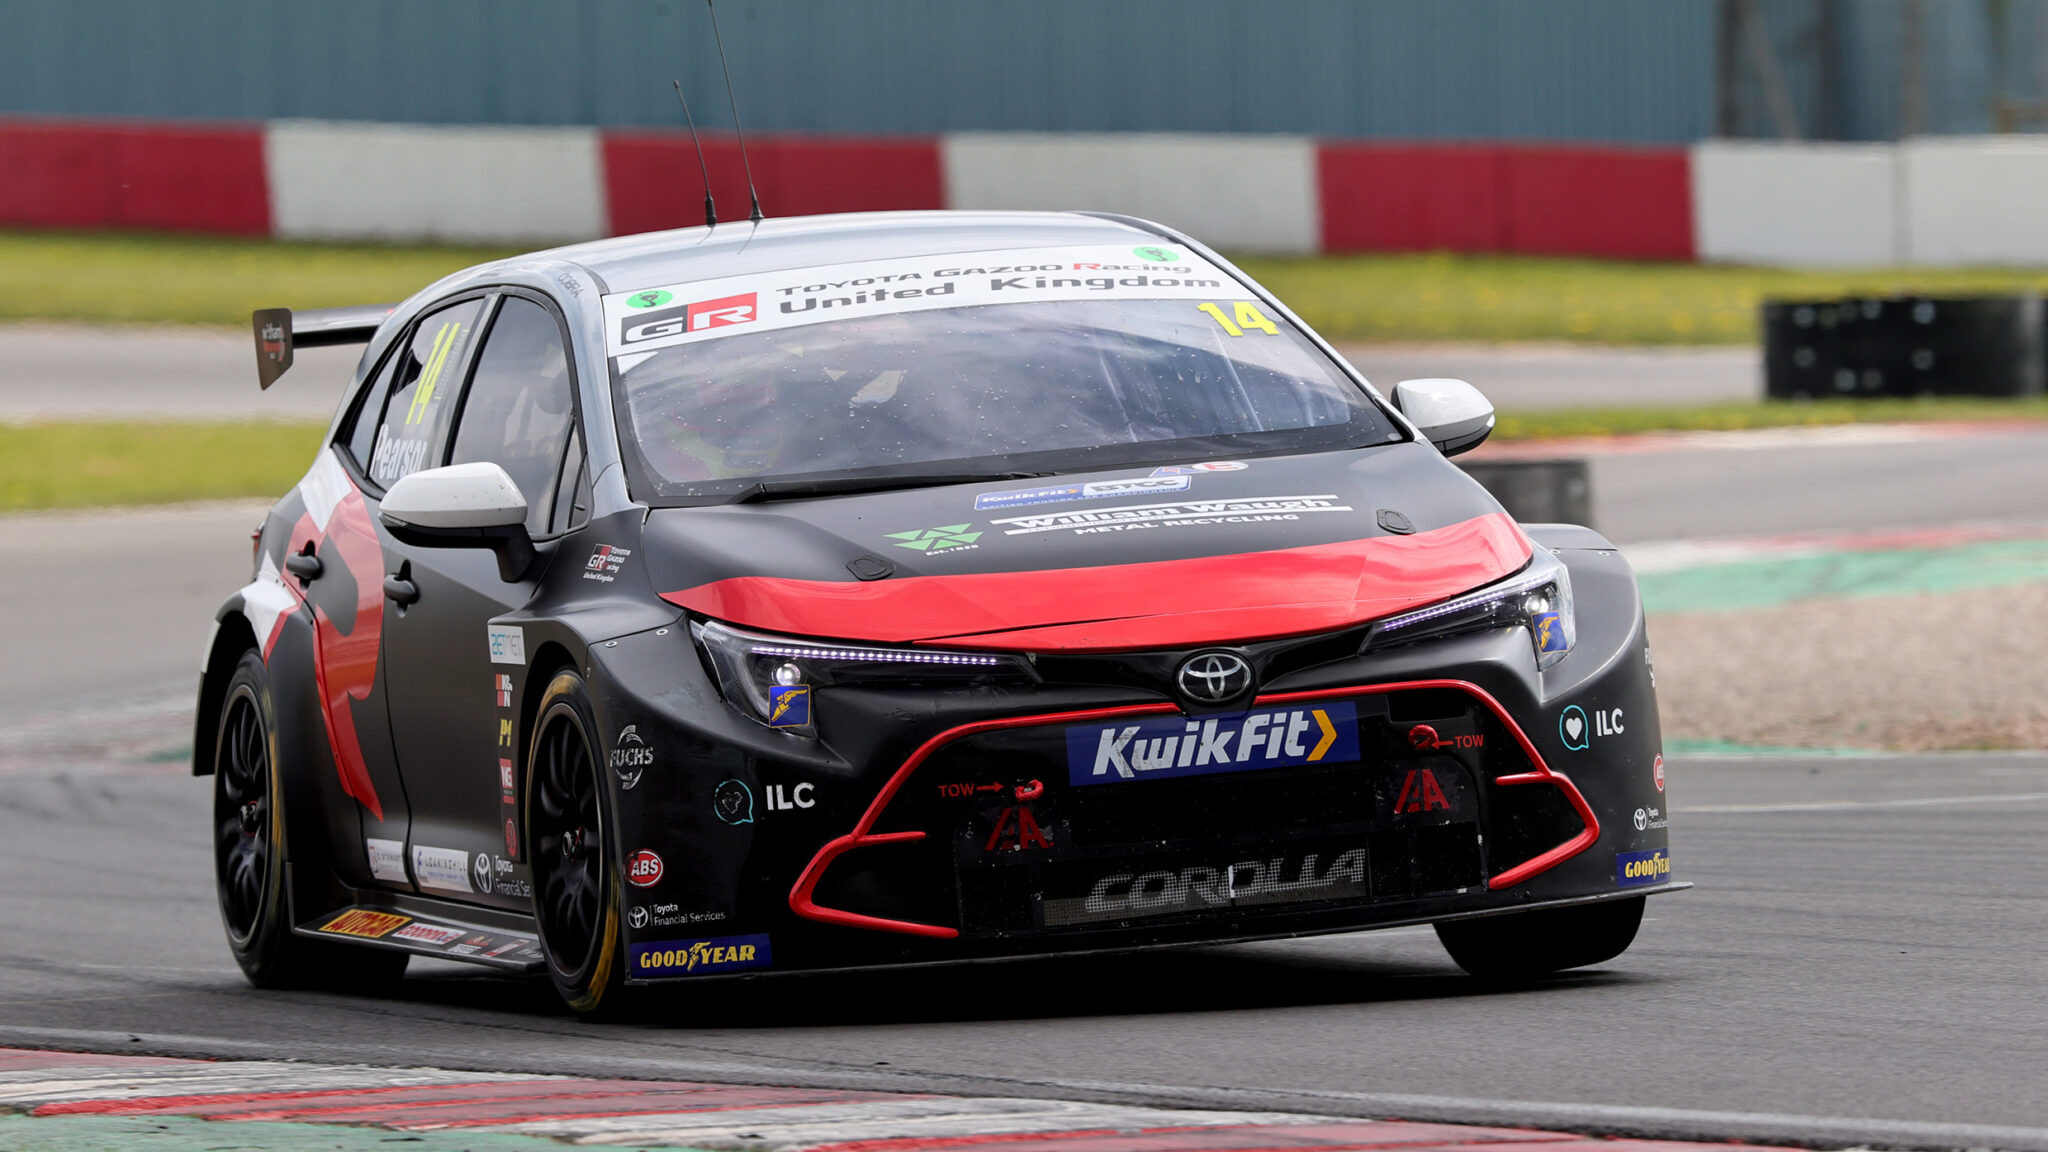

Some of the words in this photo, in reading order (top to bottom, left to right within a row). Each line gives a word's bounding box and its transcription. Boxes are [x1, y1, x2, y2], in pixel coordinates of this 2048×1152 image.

[775, 272, 922, 296] TOYOTA
[933, 264, 1063, 277] GAZOO
[1073, 262, 1192, 274] Racing
[779, 282, 955, 314] United
[990, 275, 1220, 291] Kingdom
[625, 304, 753, 342] GR
[1196, 301, 1280, 337] 14
[1009, 508, 1181, 528] William
[1182, 499, 1333, 512] Waugh
[1074, 521, 1159, 535] METAL
[1162, 513, 1300, 527] RECYCLING
[587, 554, 607, 568] GR
[1595, 707, 1625, 737] ILC
[1454, 734, 1485, 749] TOW
[609, 746, 654, 768] FUCHS
[765, 782, 816, 811] ILC
[937, 783, 975, 798] TOW
[495, 855, 514, 876] Toyota
[631, 858, 659, 877] ABS
[1085, 848, 1366, 913] COROLLA
[653, 903, 679, 915] Toyota
[654, 913, 689, 926] Financial
[689, 911, 726, 923] Services
